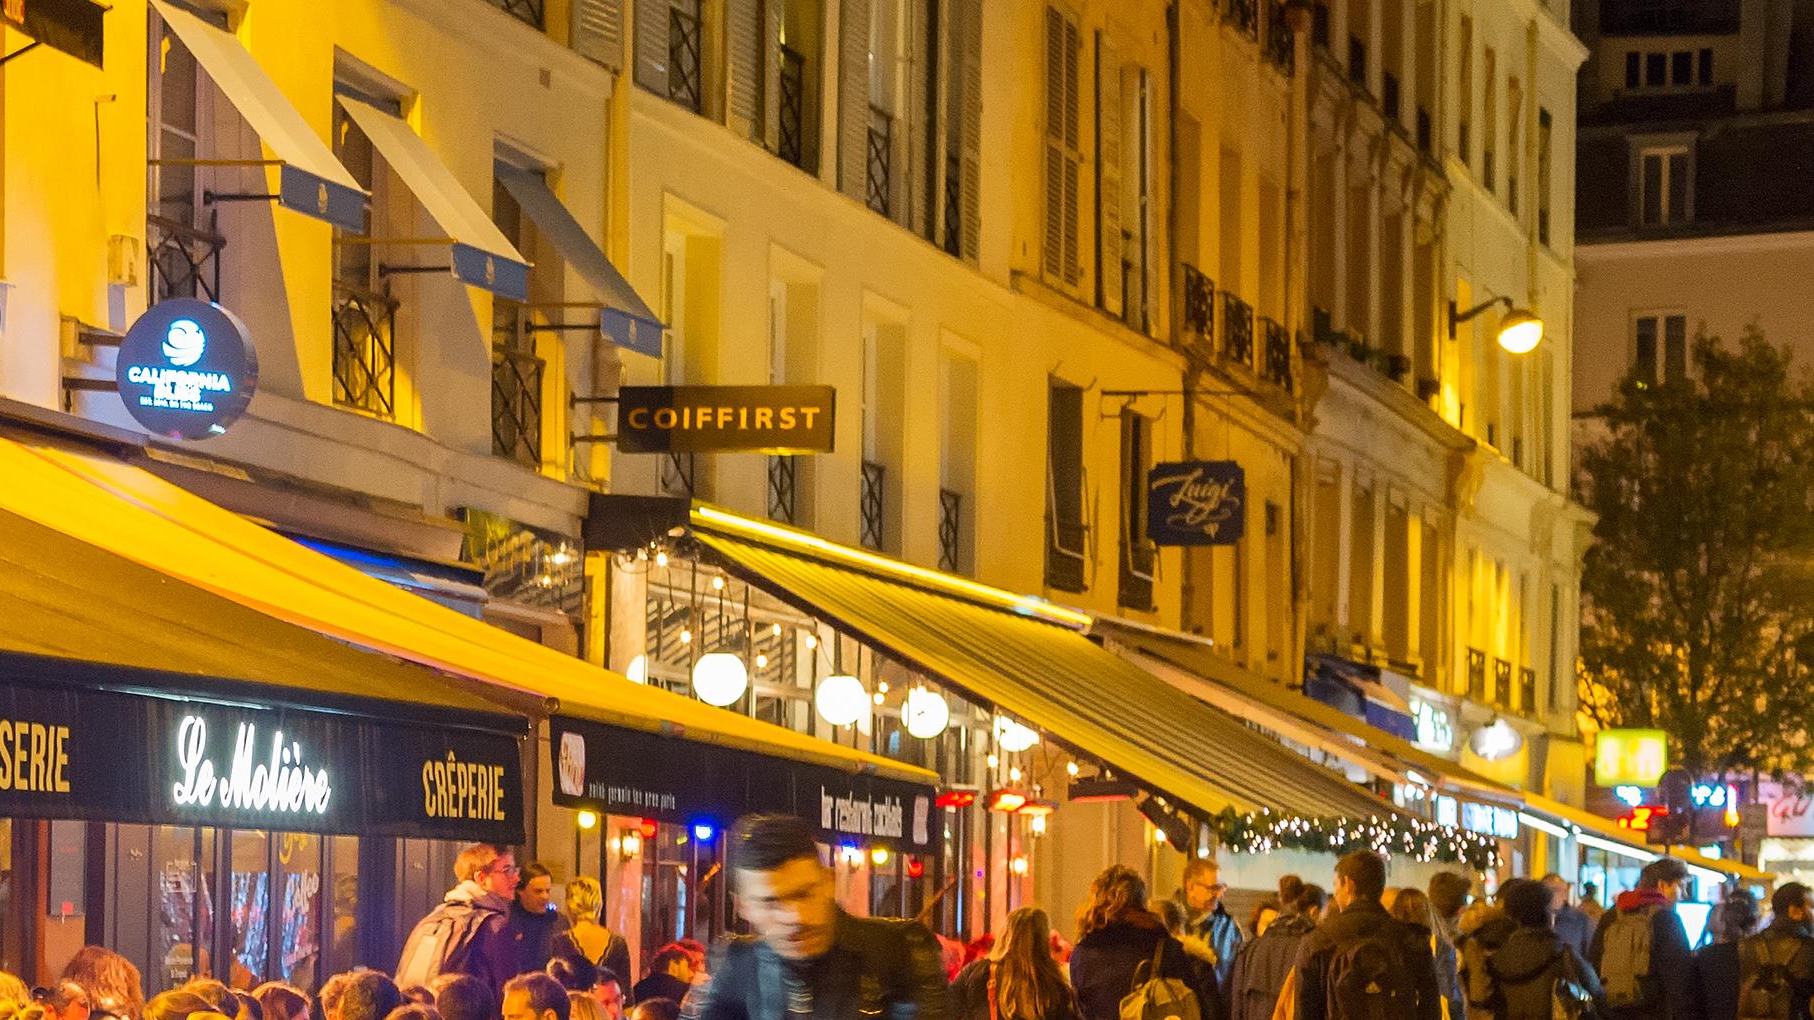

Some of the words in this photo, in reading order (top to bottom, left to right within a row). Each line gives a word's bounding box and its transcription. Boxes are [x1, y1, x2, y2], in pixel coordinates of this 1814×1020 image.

[128, 366, 231, 392] CALIFORNIA
[1152, 467, 1240, 526] Luigi
[174, 715, 217, 806] Le
[219, 721, 332, 814] Molière
[422, 751, 506, 821] CRÊPERIE
